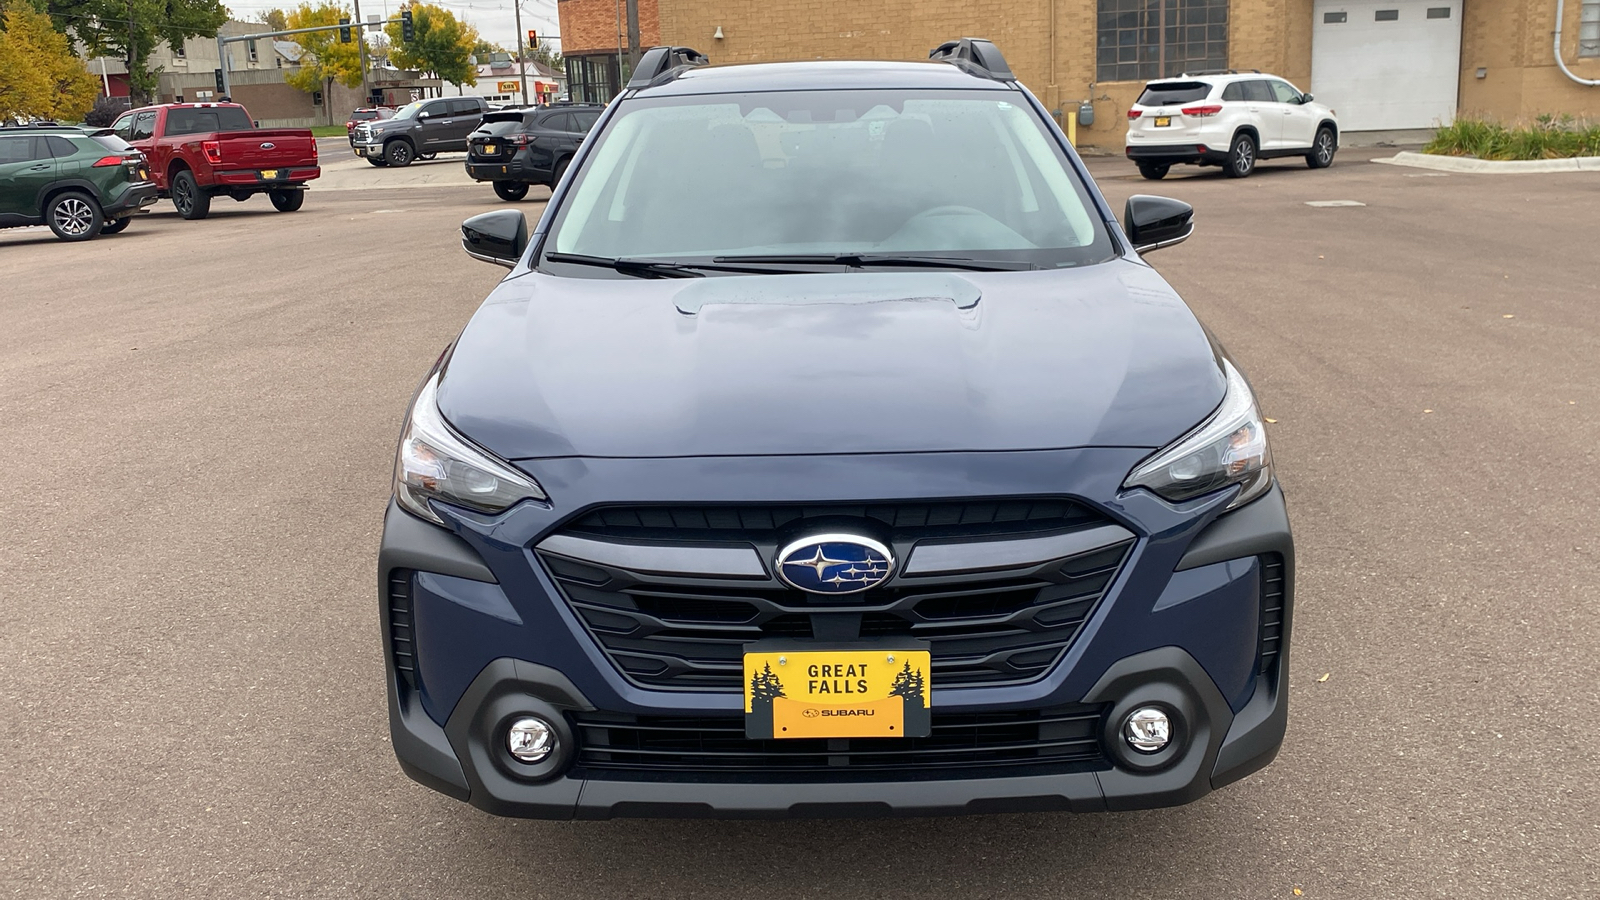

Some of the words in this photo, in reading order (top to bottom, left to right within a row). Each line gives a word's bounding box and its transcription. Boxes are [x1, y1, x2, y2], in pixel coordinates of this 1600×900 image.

[808, 664, 868, 677] GREAT
[808, 679, 868, 694] FALLS
[821, 709, 875, 717] SUBARU
